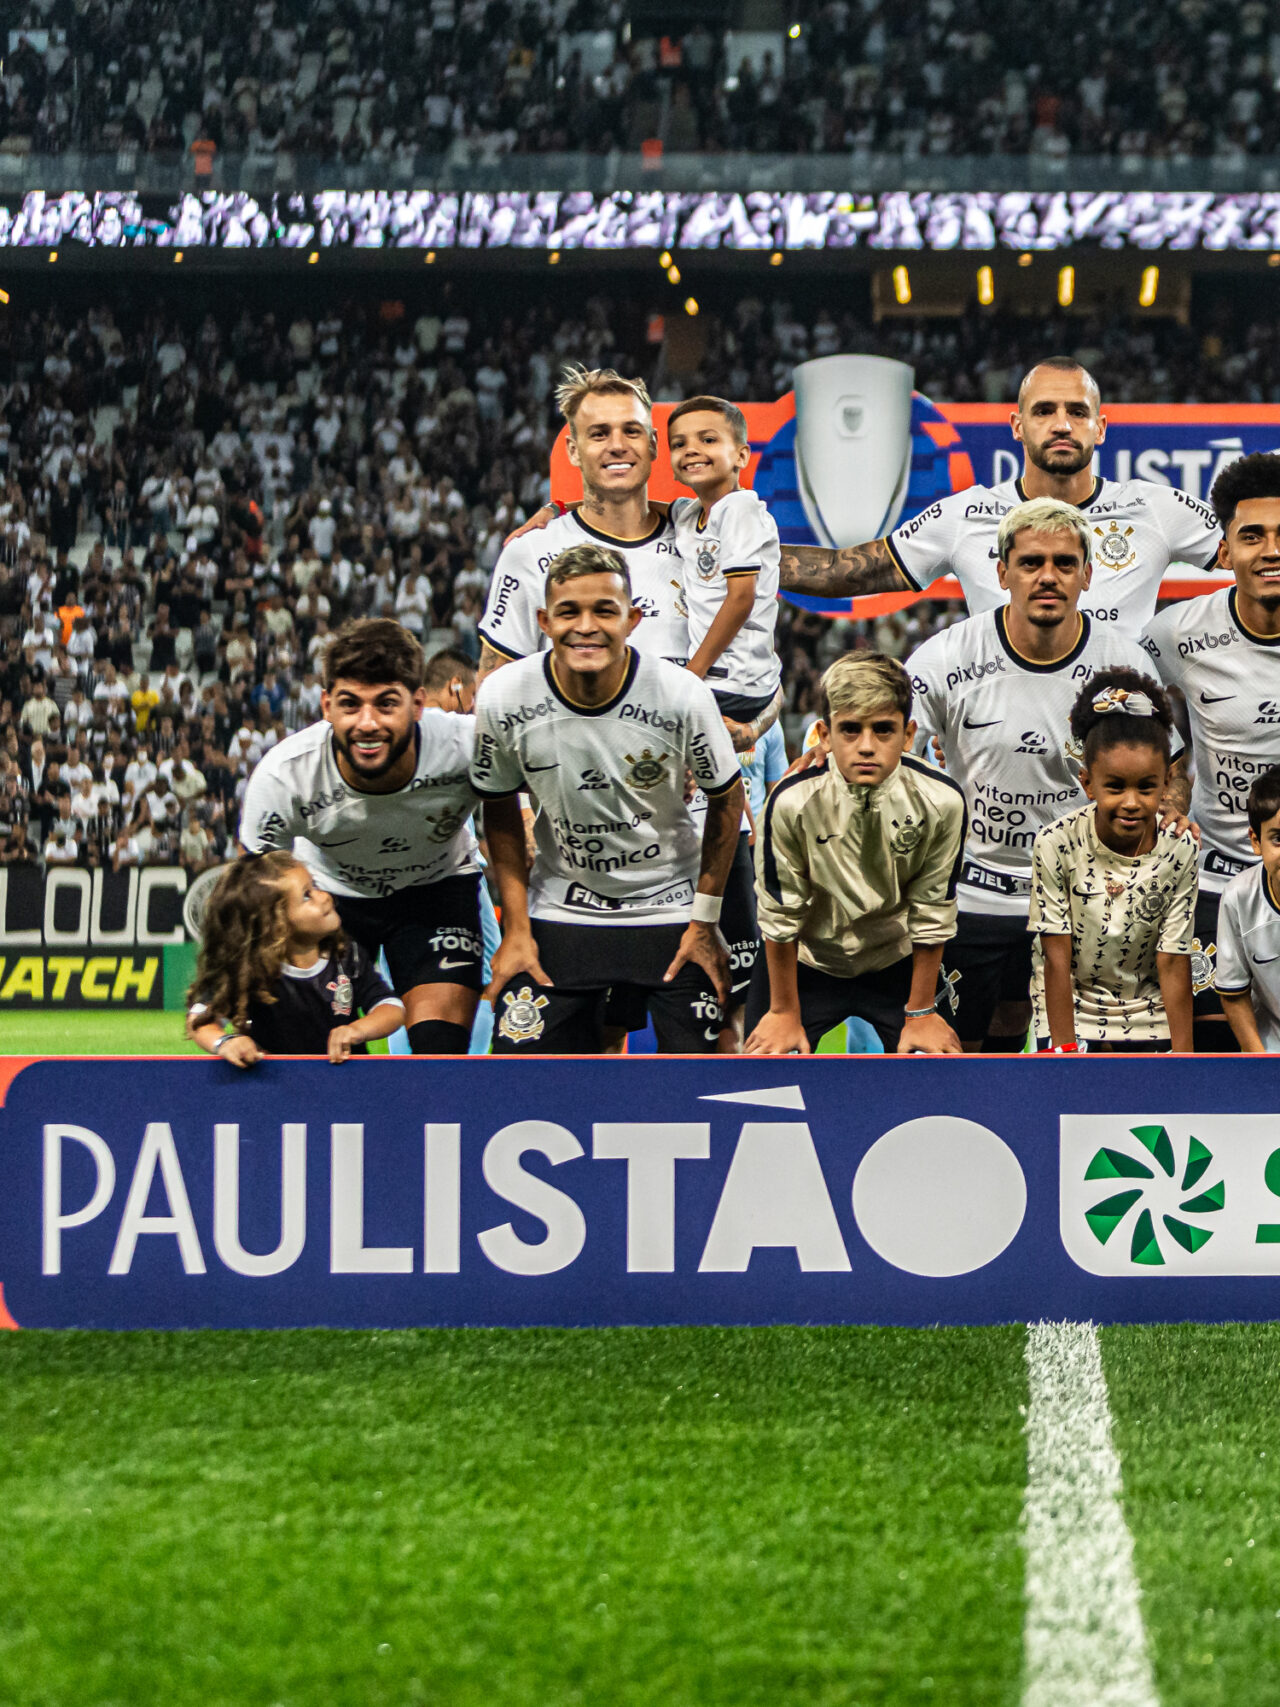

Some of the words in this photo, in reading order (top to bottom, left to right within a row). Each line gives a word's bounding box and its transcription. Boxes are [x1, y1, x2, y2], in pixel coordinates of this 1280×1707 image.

[910, 502, 942, 535] bmg
[1185, 495, 1219, 530] bmg
[1177, 627, 1239, 659] pixbet
[946, 656, 1006, 691] pixbet
[618, 703, 684, 734] pixbet
[694, 745, 715, 780] bmg
[1014, 746, 1048, 755] ALE
[974, 781, 1080, 806] vitaminas
[1217, 771, 1249, 791] ne
[974, 798, 1026, 826] neo
[967, 867, 1007, 892] FIEL
[0, 956, 159, 1001] ATCH
[42, 1085, 1028, 1278] PAULISTÃO
